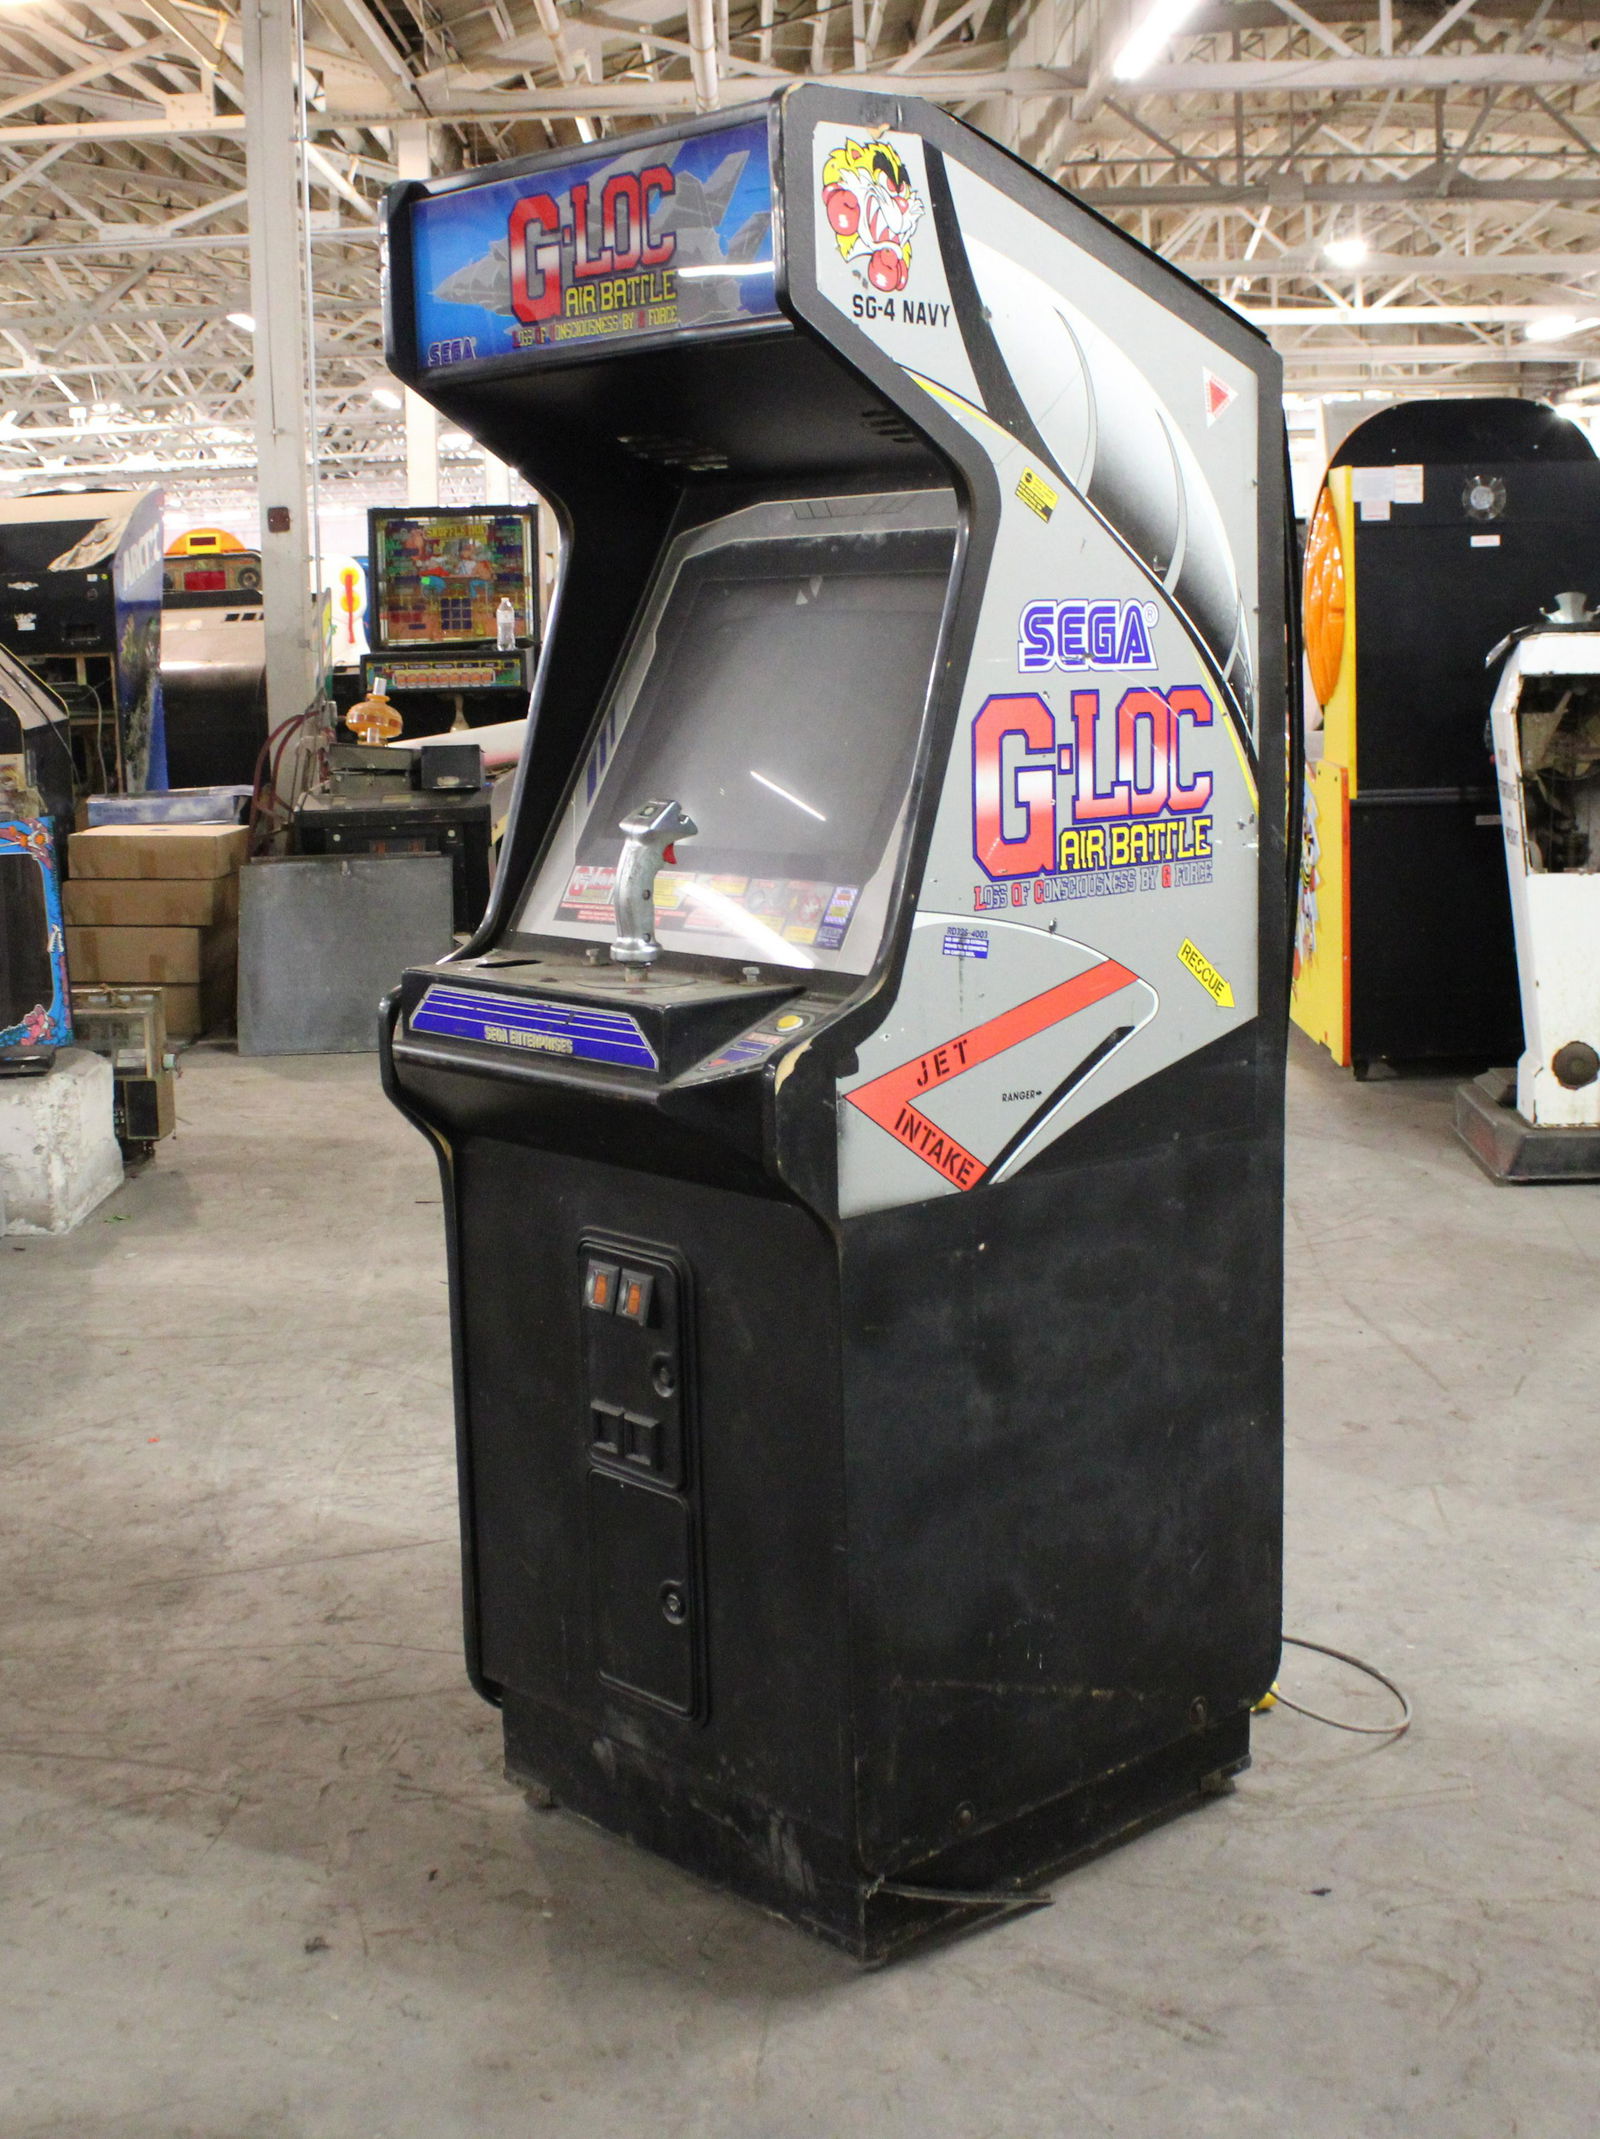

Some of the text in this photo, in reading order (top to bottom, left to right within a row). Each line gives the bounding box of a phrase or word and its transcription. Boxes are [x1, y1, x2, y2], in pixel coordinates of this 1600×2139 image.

[564, 267, 678, 319] AIR BATTLE
[623, 311, 634, 330] BY
[648, 305, 678, 326] FORCE
[853, 294, 950, 328] SG-4 NAVY
[428, 336, 477, 367] SEGA
[1018, 598, 1158, 672] SEGA
[1058, 815, 1213, 874] AIR BATTLE
[974, 860, 1213, 911] LOSS OF CONSCIOUSNESS BY G FORCE
[1181, 943, 1225, 998] RESCUE
[484, 1025, 574, 1054] SEGA ENTERPRISES
[916, 1039, 968, 1087] JET
[1002, 1090, 1036, 1102] RANGER
[894, 1107, 975, 1186] INTAKE
